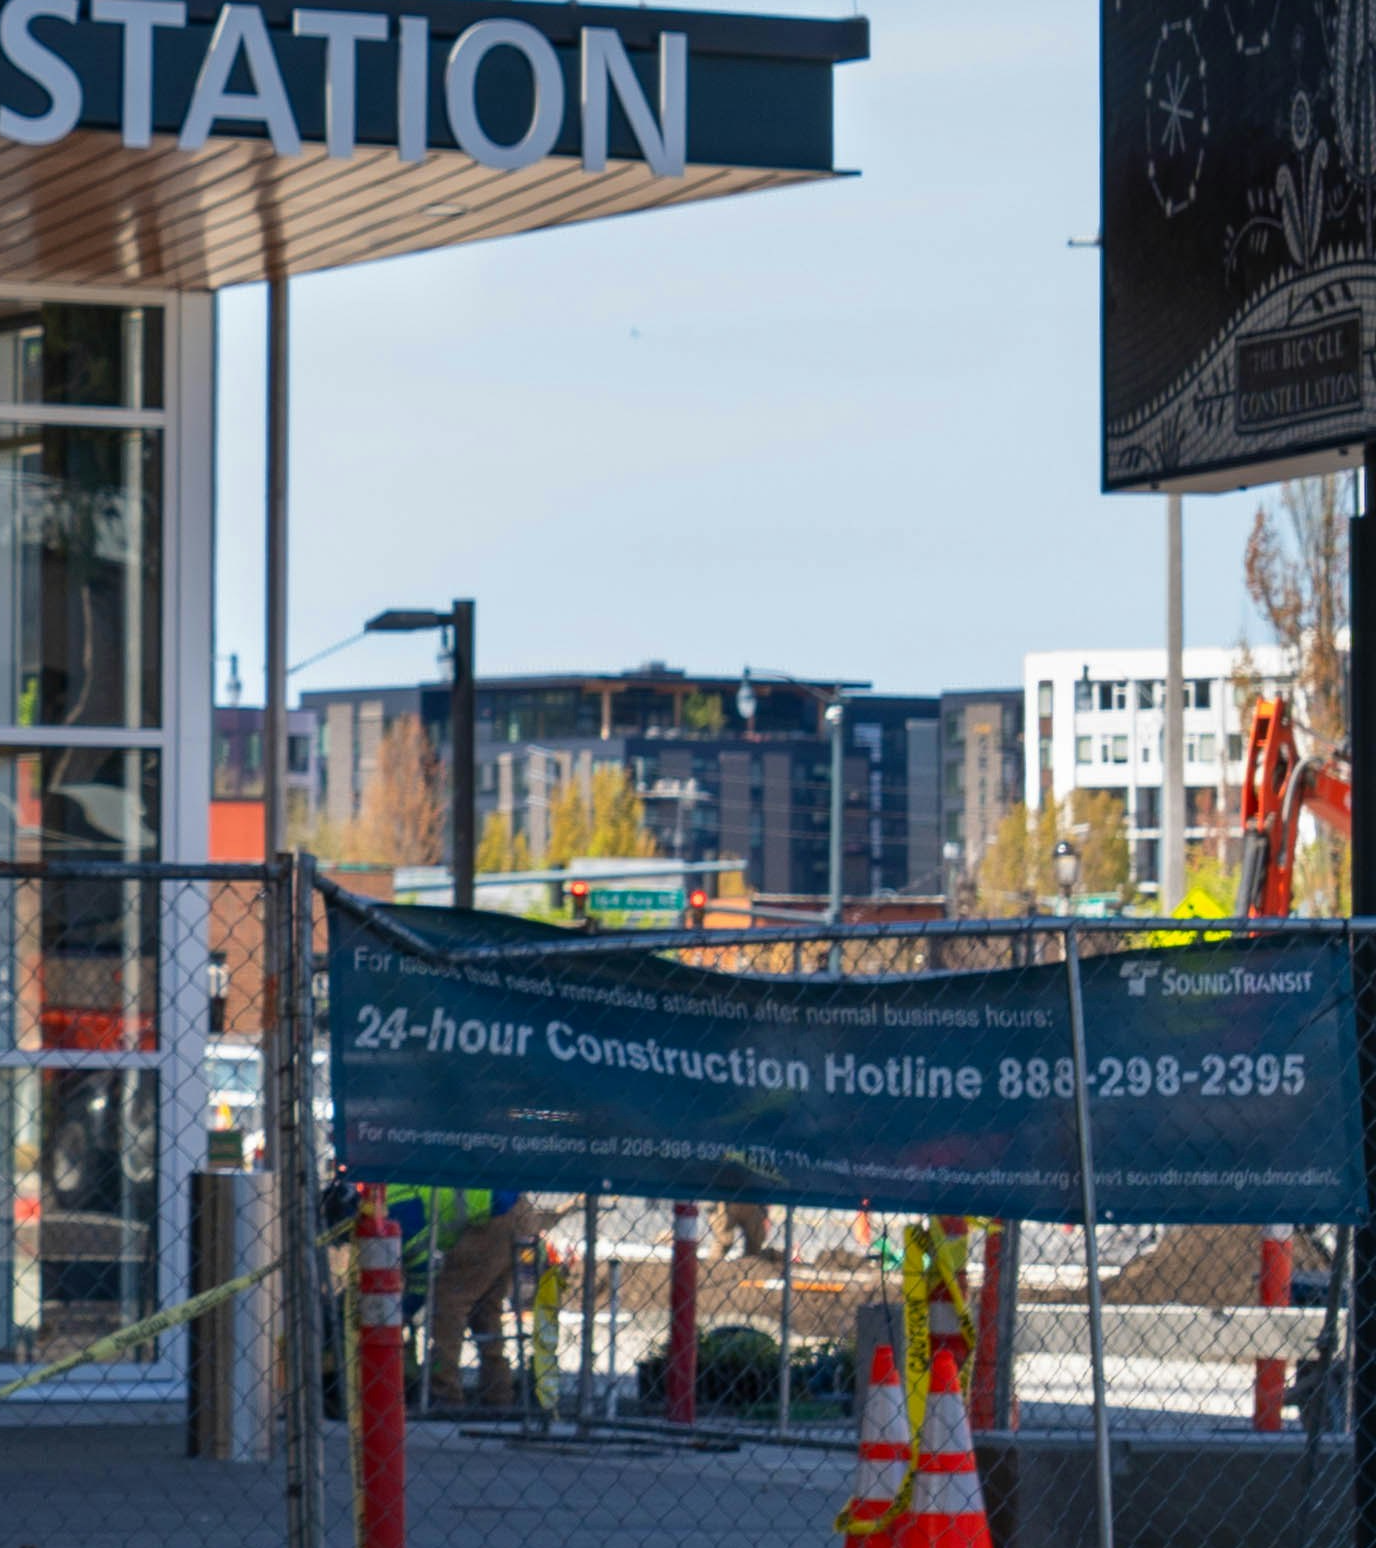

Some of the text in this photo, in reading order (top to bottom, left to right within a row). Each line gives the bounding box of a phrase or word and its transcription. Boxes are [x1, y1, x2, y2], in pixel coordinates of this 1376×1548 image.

[1250, 329, 1344, 374] THE BICYCLE
[1239, 370, 1359, 421] CONSTELLATION
[353, 945, 392, 972] For
[505, 974, 554, 997] need
[556, 982, 657, 1011] immediate
[662, 993, 748, 1020] attention
[754, 999, 800, 1024] after
[805, 1002, 878, 1025] normal
[883, 1003, 980, 1028] business
[985, 1003, 1055, 1029] hours:
[354, 1003, 1307, 1100] 24-hour Construction Hotline 888-298-2395
[358, 1121, 385, 1142] For
[386, 1126, 509, 1152] non-emergency
[511, 1132, 587, 1155] questions
[589, 1134, 619, 1155] call
[907, 1299, 929, 1374] CAUTION
